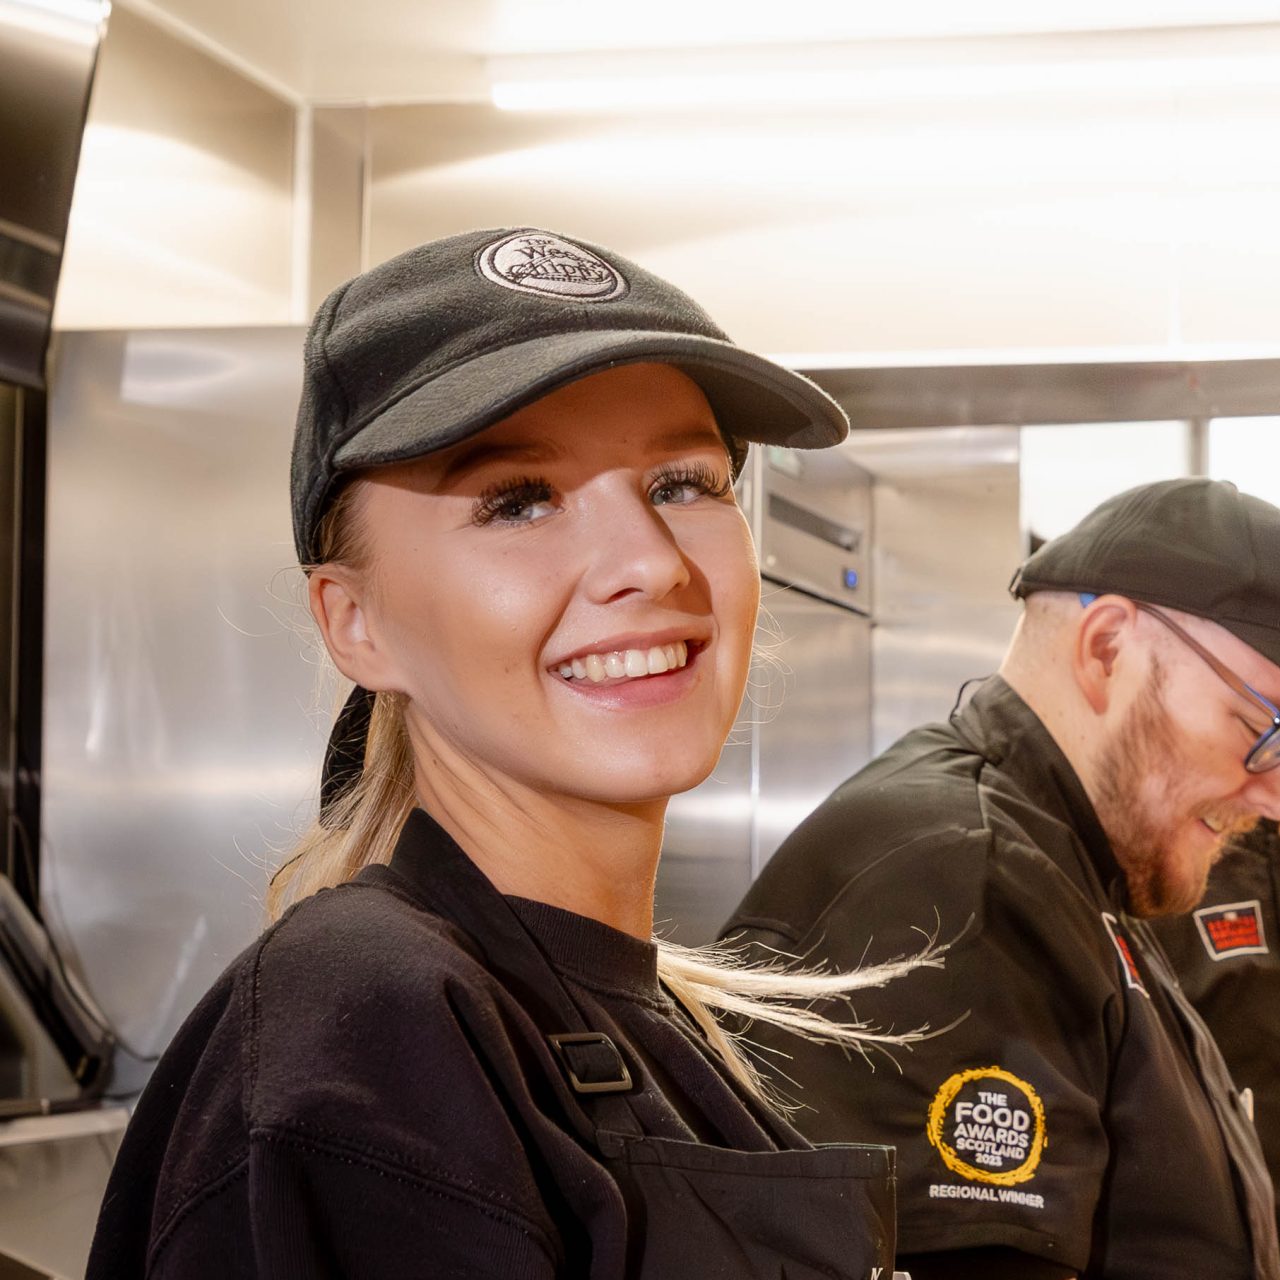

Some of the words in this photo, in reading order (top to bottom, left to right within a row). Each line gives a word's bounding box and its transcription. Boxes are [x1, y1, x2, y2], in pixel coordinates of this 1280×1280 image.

[977, 1091, 1008, 1107] THE
[955, 1102, 1031, 1132] FOOD
[953, 1123, 1030, 1149] AWARDS
[956, 1138, 1025, 1160] SCOTLAND
[929, 1184, 999, 1202] REGIONAL
[998, 1188, 1045, 1209] WINNER
